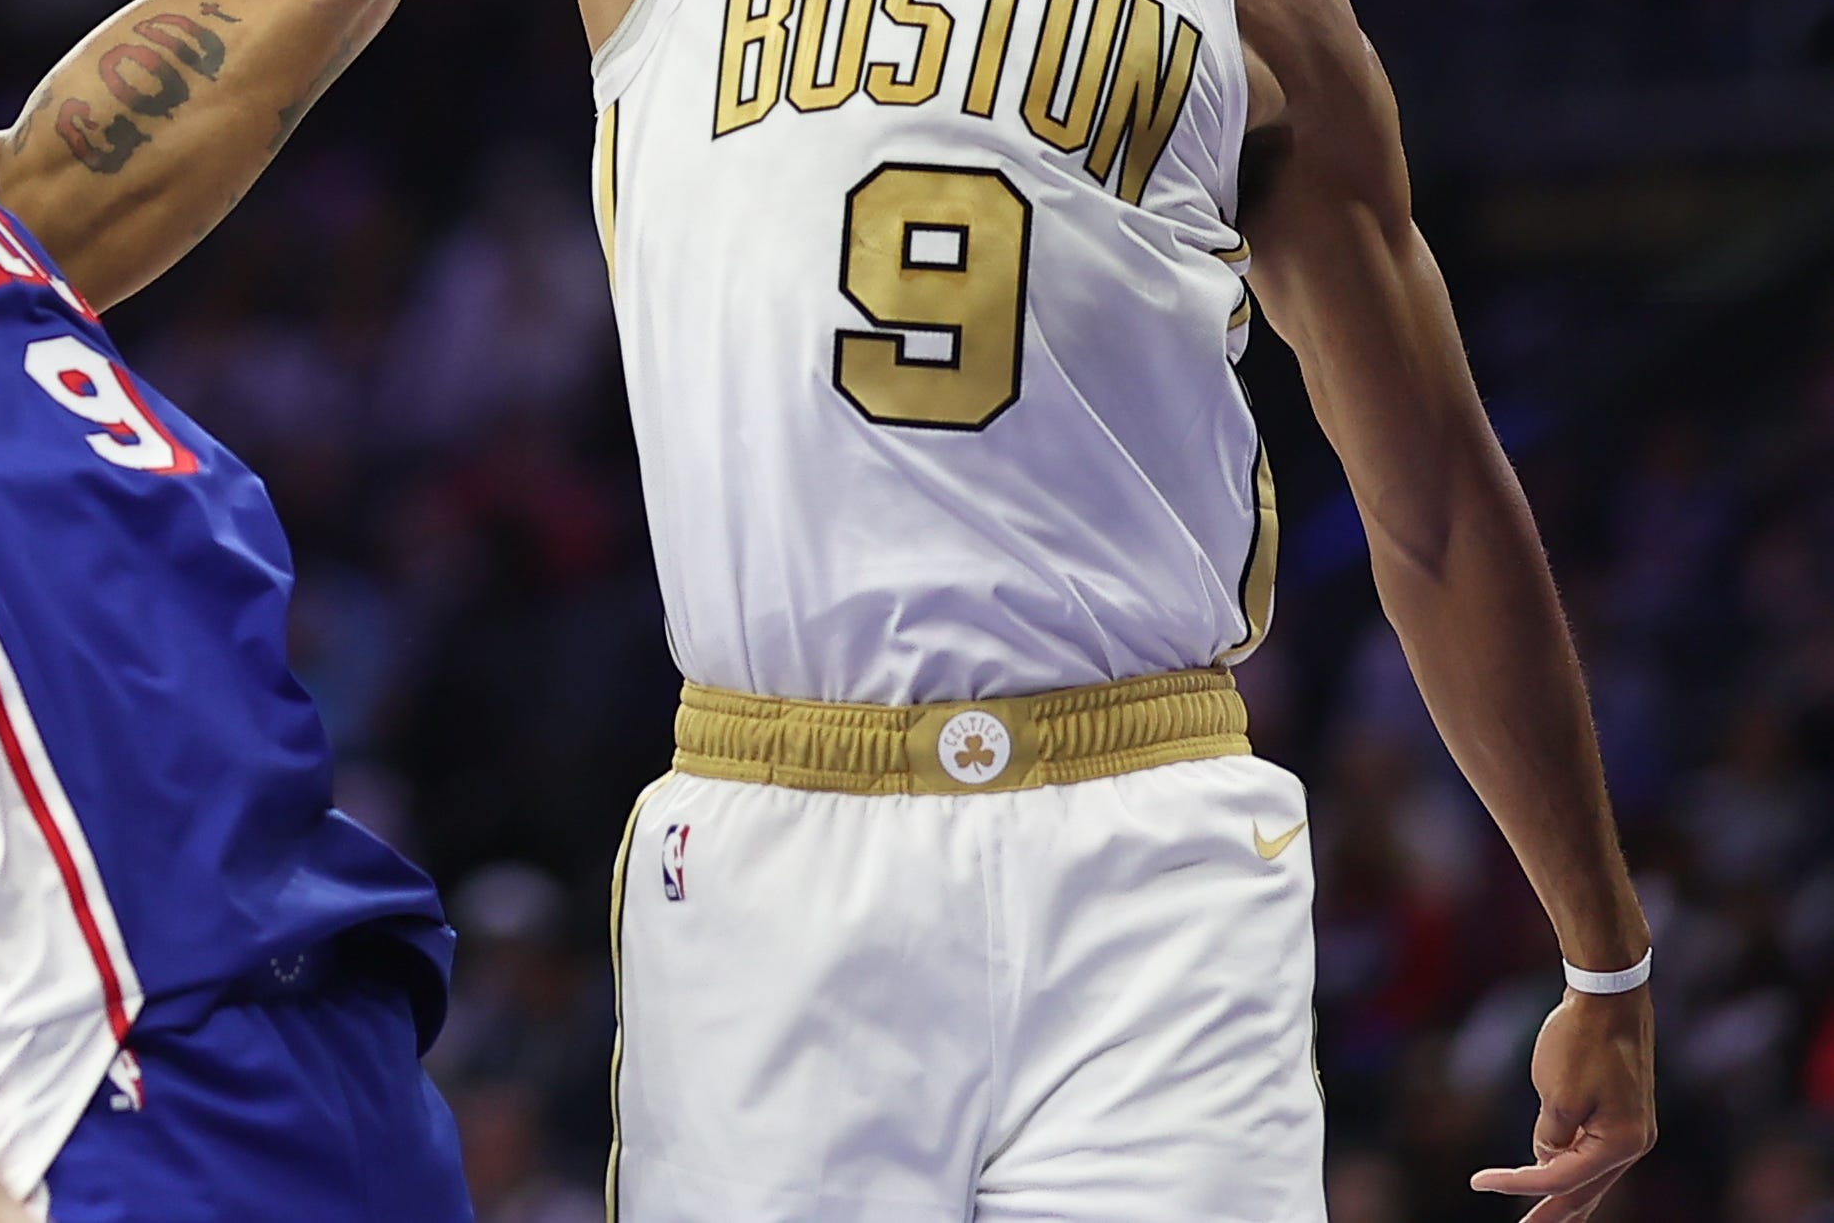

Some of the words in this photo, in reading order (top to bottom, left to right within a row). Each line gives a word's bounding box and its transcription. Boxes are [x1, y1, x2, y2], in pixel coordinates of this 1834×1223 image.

[833, 162, 1032, 431] 9
[23, 334, 198, 474] 9
[944, 716, 1004, 747] CELTICS
